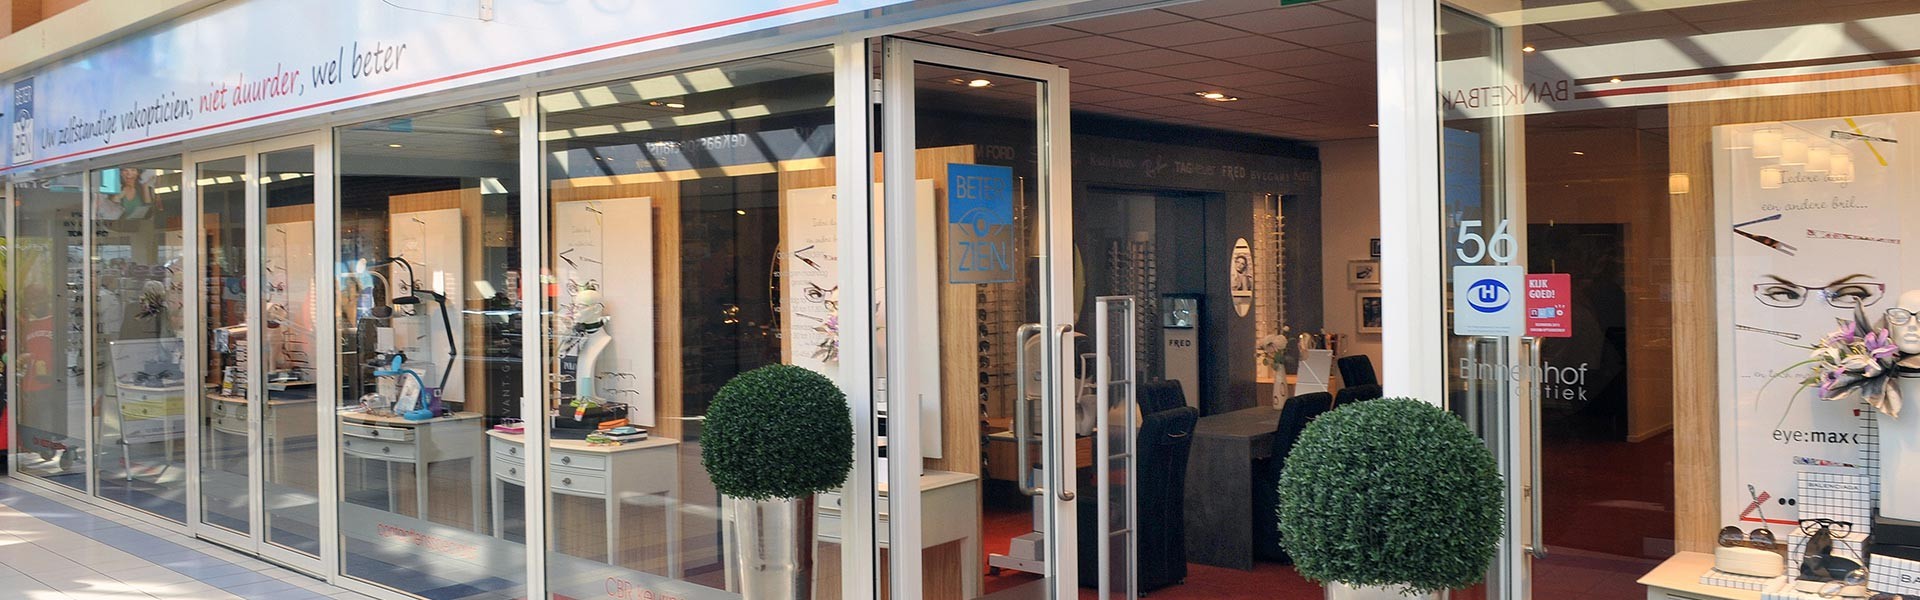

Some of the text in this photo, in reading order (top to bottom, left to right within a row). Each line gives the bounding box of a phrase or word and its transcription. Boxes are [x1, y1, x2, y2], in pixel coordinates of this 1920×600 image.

[41, 41, 407, 149] Uw zelfstandige vakopticien; niet duurder, wel beter
[987, 145, 1015, 160] FORD
[1222, 165, 1246, 181] FRED
[956, 175, 1006, 200] BETER
[1761, 202, 1781, 212] een
[1785, 198, 1827, 211] andere
[1456, 219, 1518, 264] 56
[958, 241, 1008, 272] ZIEN
[1528, 279, 1548, 288] KIJK
[1528, 290, 1555, 299] GOED!
[1168, 339, 1191, 348] FRED
[1459, 357, 1588, 386] Binnenhof
[605, 576, 632, 600] CBR
